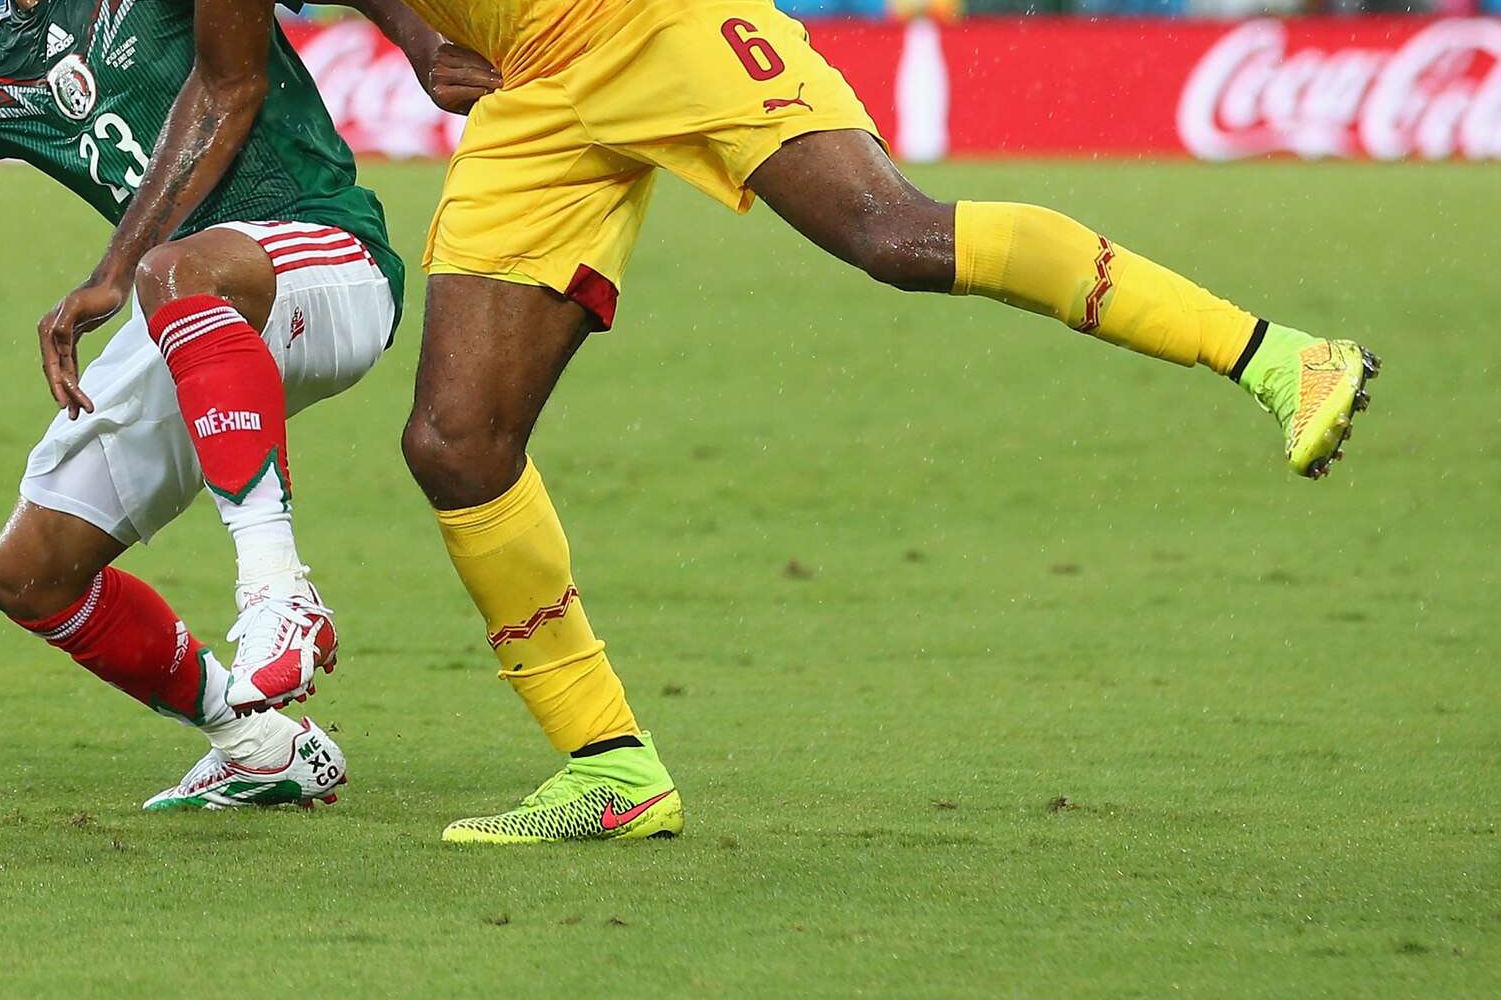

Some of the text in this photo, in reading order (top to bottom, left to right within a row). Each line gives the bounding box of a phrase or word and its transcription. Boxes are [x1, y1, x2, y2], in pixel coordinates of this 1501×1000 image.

[45, 33, 75, 58] didas
[720, 17, 786, 81] 6
[79, 112, 150, 204] 23
[194, 407, 262, 439] MÉXICO
[298, 736, 322, 760] ME
[308, 750, 332, 774] XI
[316, 765, 339, 787] CO
